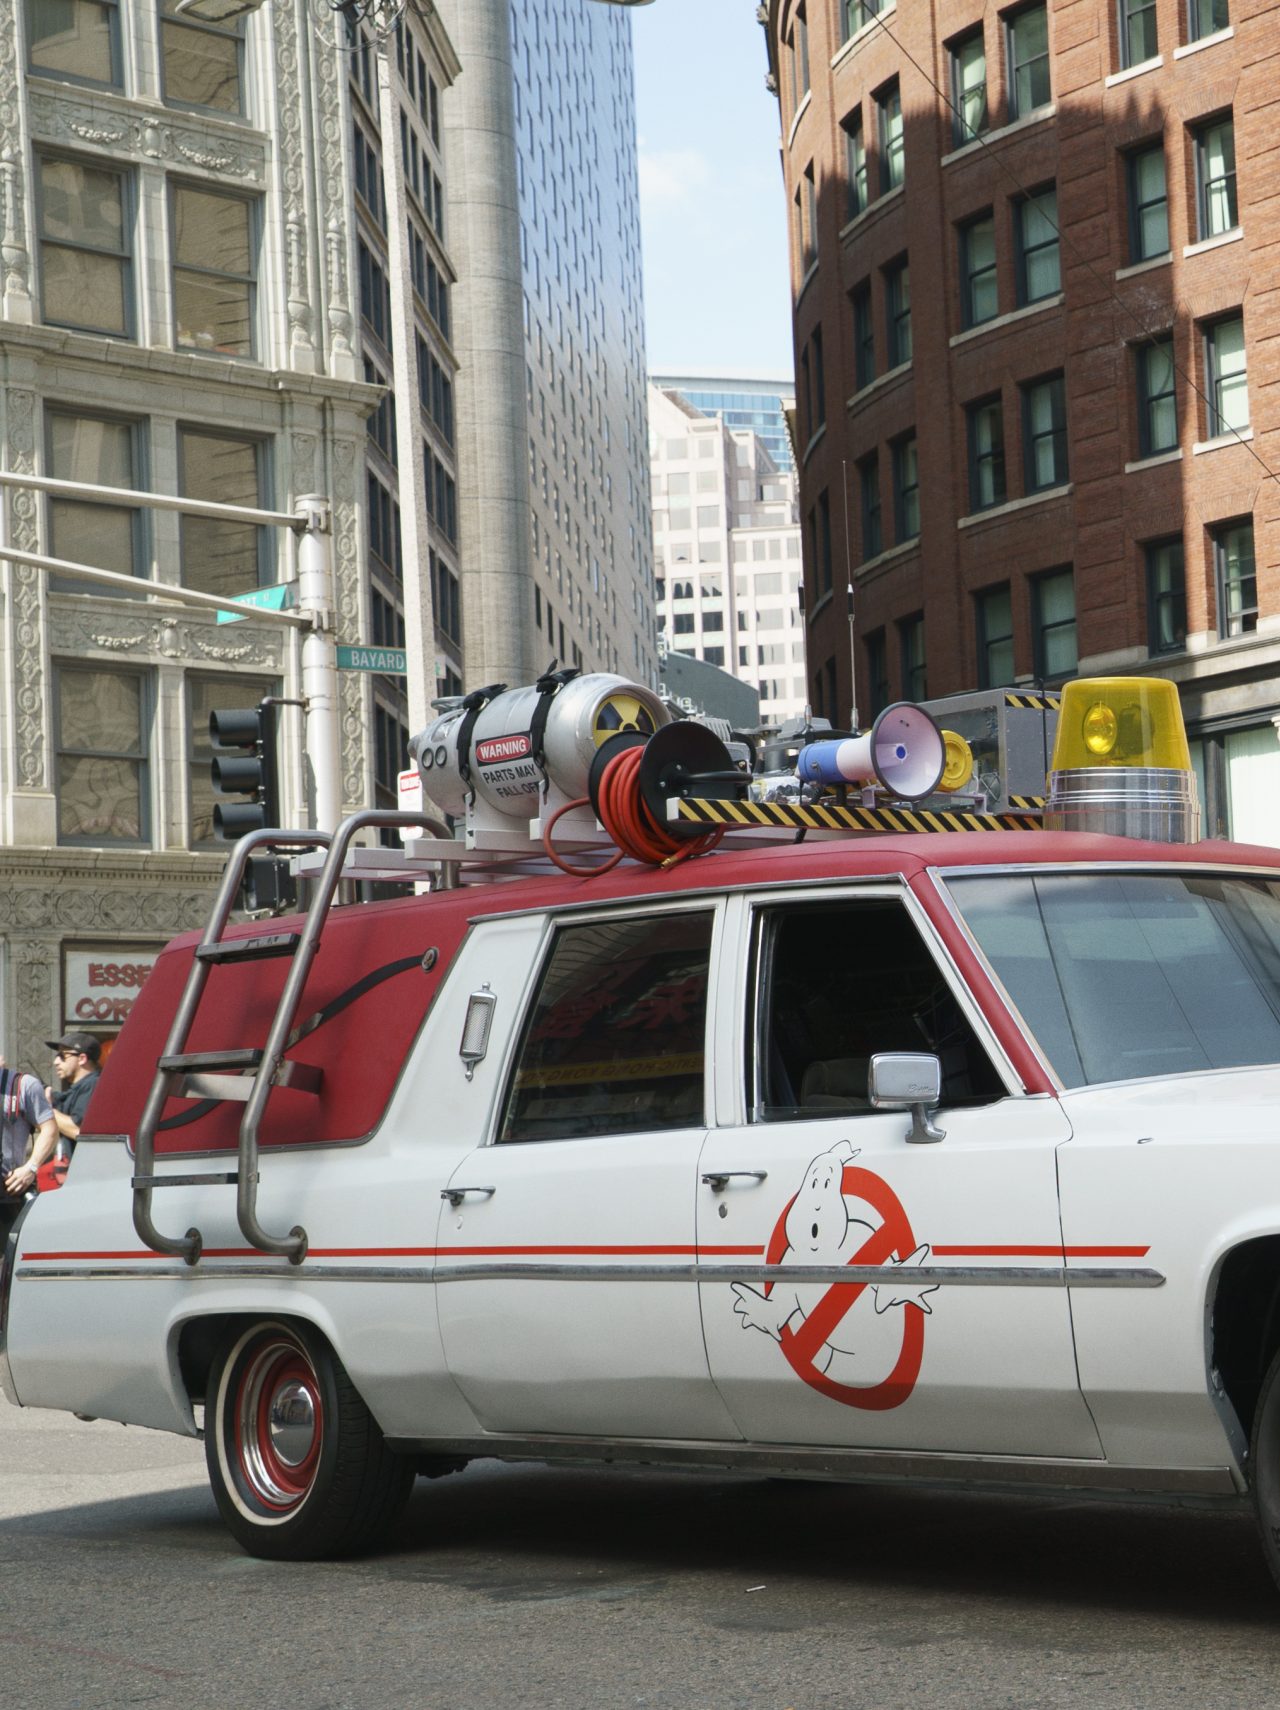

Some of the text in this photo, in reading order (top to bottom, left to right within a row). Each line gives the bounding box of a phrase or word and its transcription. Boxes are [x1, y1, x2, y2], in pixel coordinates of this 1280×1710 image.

[351, 650, 405, 671] BAYARD
[480, 738, 527, 759] WARNING
[482, 763, 537, 784] PARTS MAY
[496, 785, 524, 798] FALL
